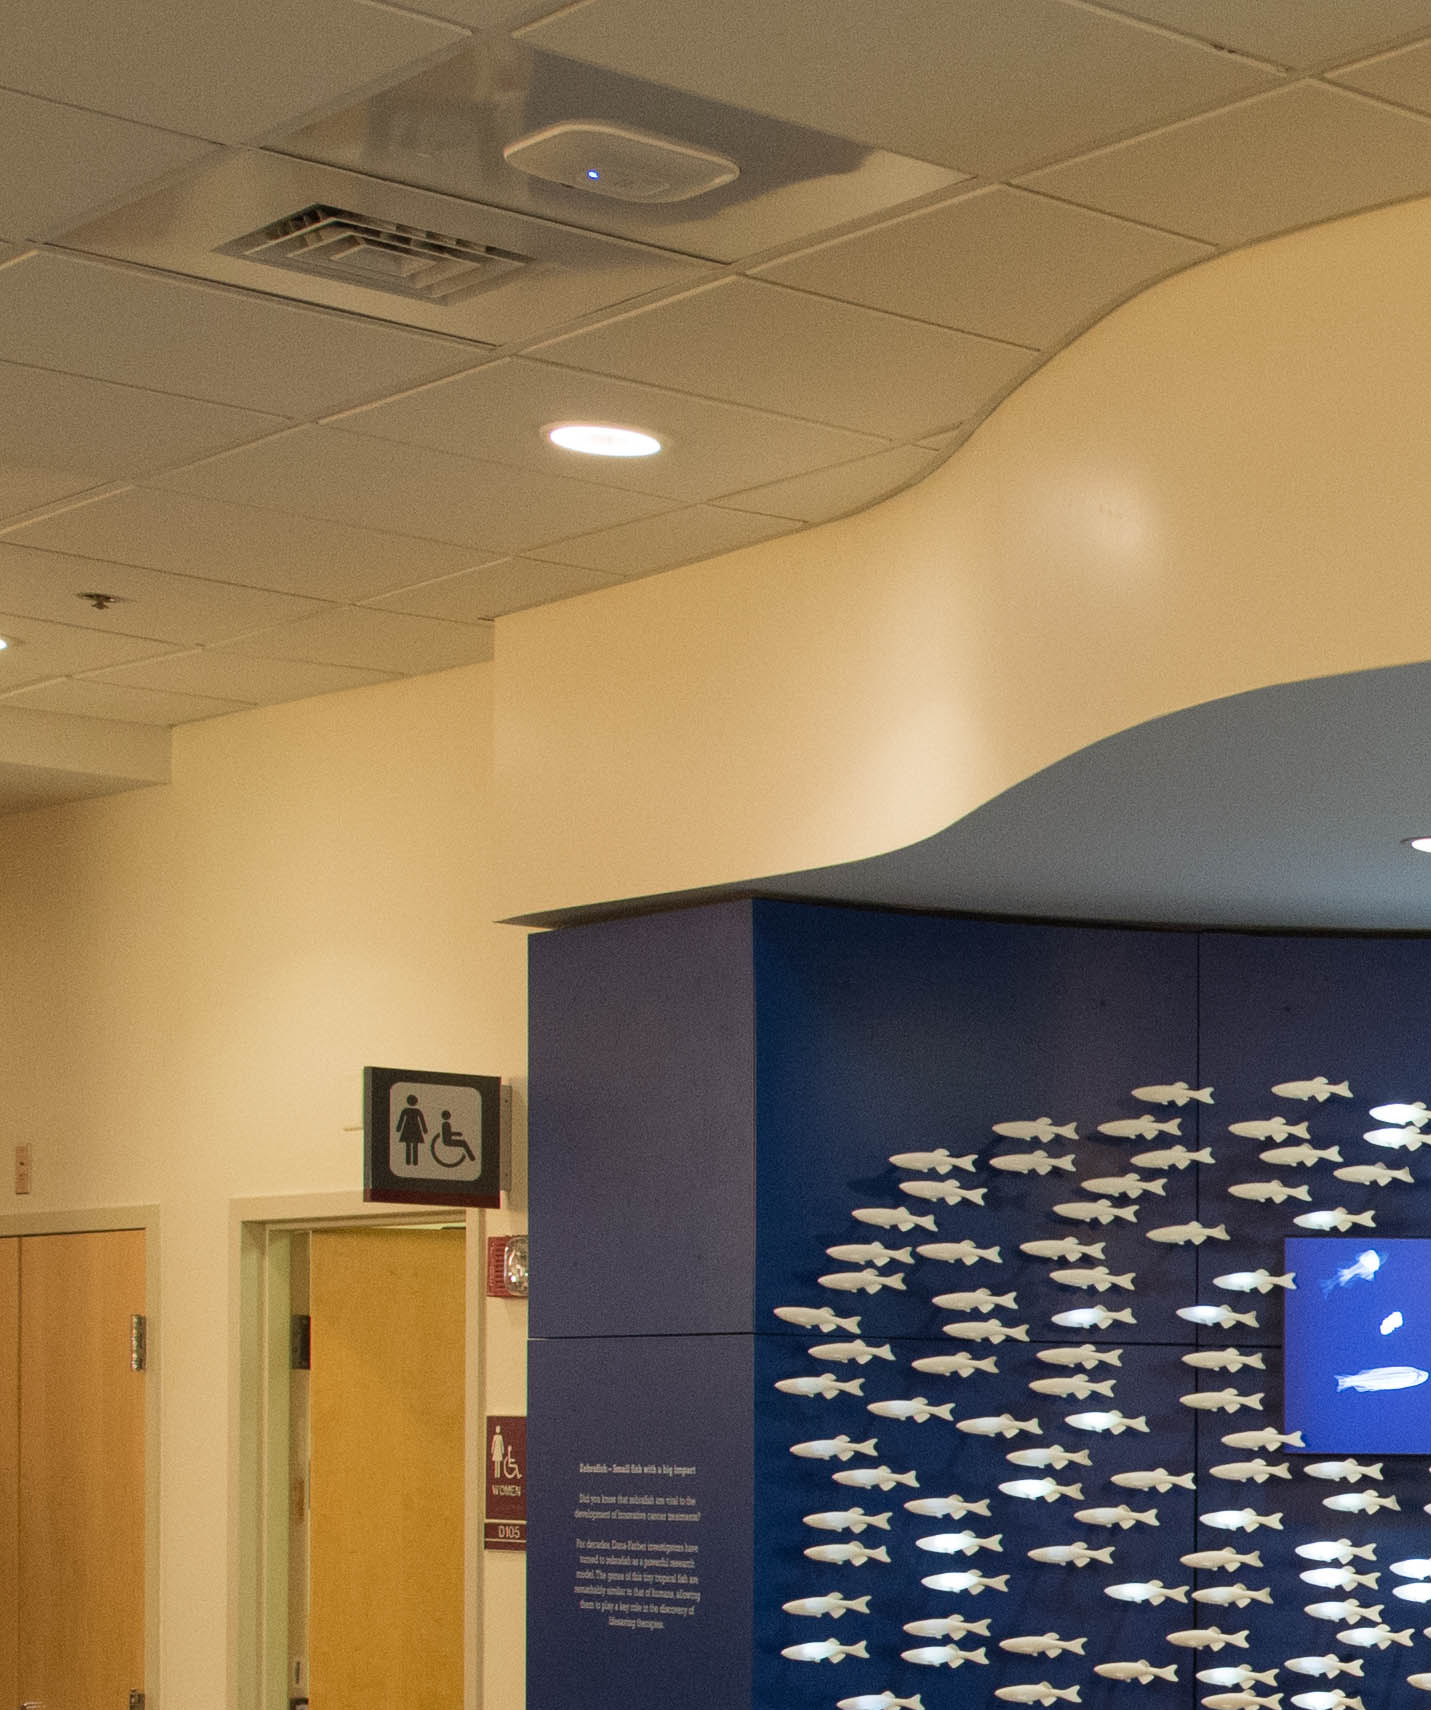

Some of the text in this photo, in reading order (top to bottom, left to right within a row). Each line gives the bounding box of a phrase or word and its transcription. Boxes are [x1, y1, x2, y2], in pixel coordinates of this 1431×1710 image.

[630, 1463, 643, 1475] fish
[643, 1464, 657, 1475] with
[662, 1463, 673, 1477] big
[672, 1464, 697, 1478] impact
[491, 1484, 523, 1497] WOMEN
[498, 1525, 521, 1539] D105
